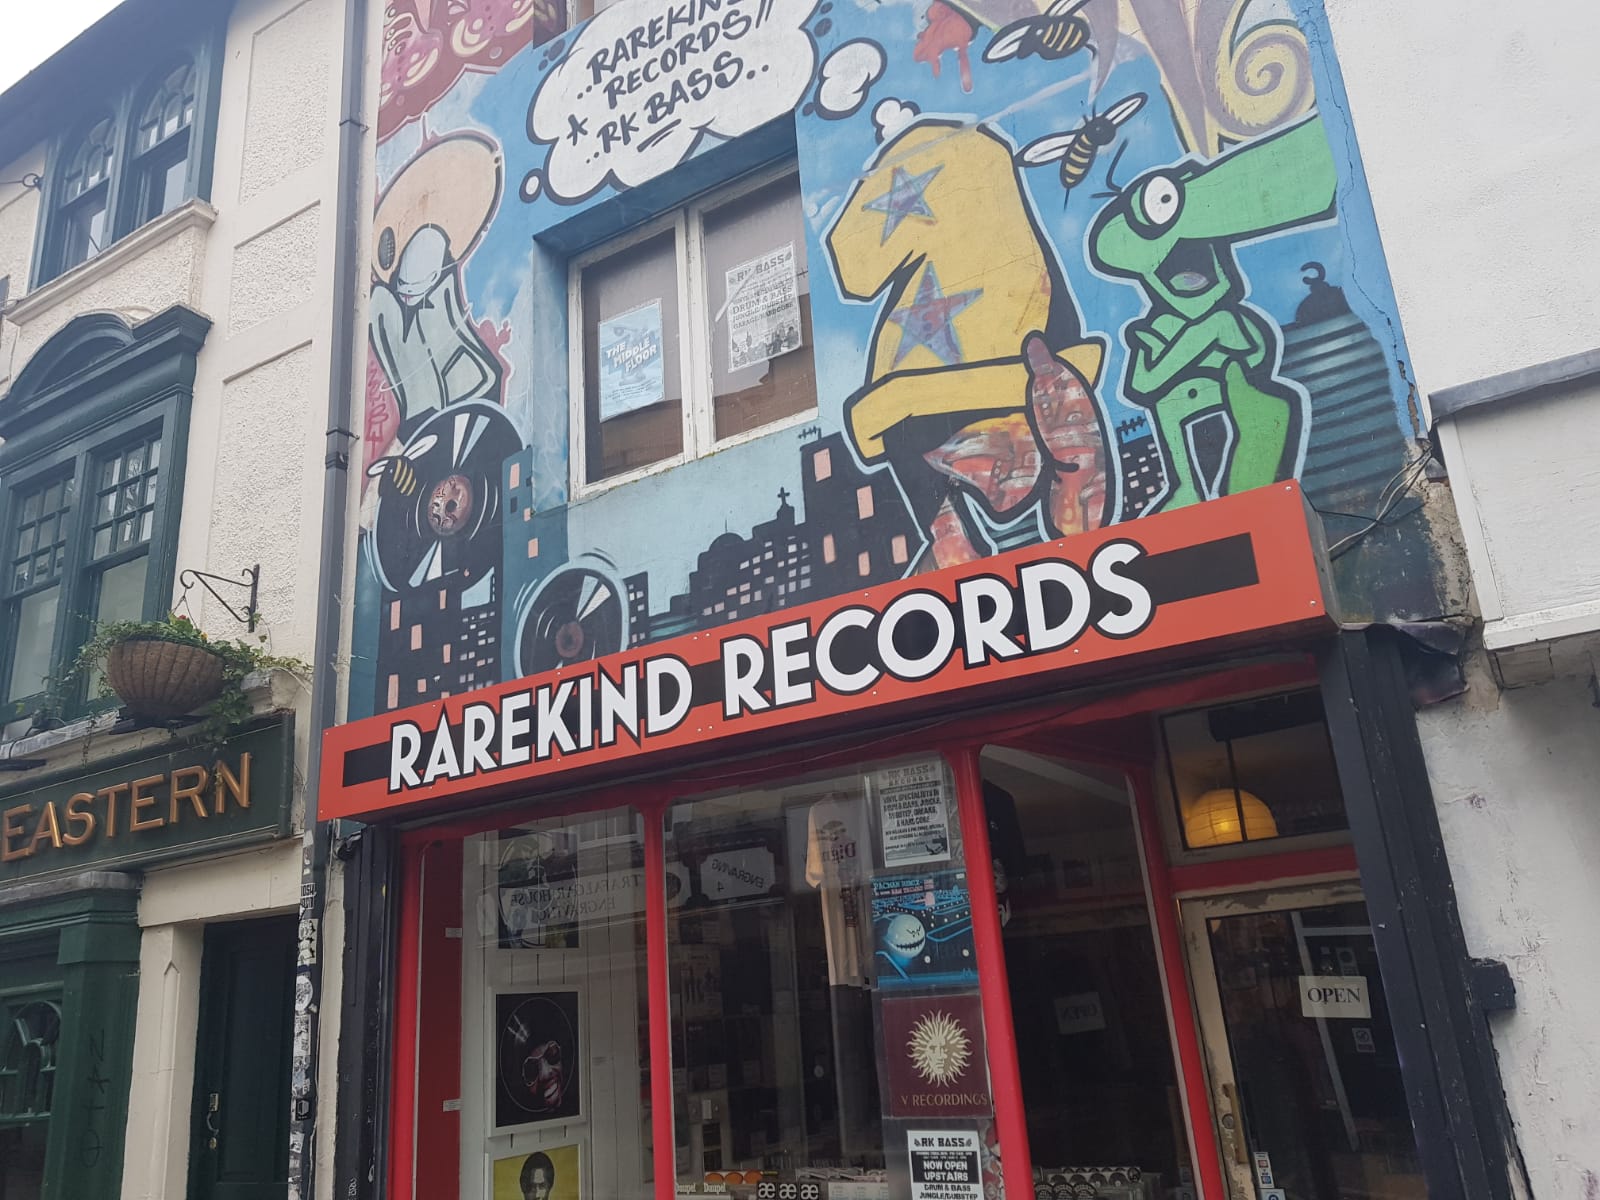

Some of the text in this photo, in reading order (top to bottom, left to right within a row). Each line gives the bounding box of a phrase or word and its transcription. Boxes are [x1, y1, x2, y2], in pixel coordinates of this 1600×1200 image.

[606, 341, 626, 359] THE
[613, 336, 650, 369] MIDDLE
[625, 344, 657, 373] FLOOR
[388, 542, 1153, 793] RAREKIND RECORDS
[1, 752, 251, 862] EASTERN
[1307, 987, 1361, 1004] OPEN
[901, 1093, 988, 1106] V RECORDINGS
[921, 1137, 965, 1147] RK BASS
[923, 1160, 968, 1171] NOW OPEN
[924, 1171, 969, 1182] UPSTAIRS
